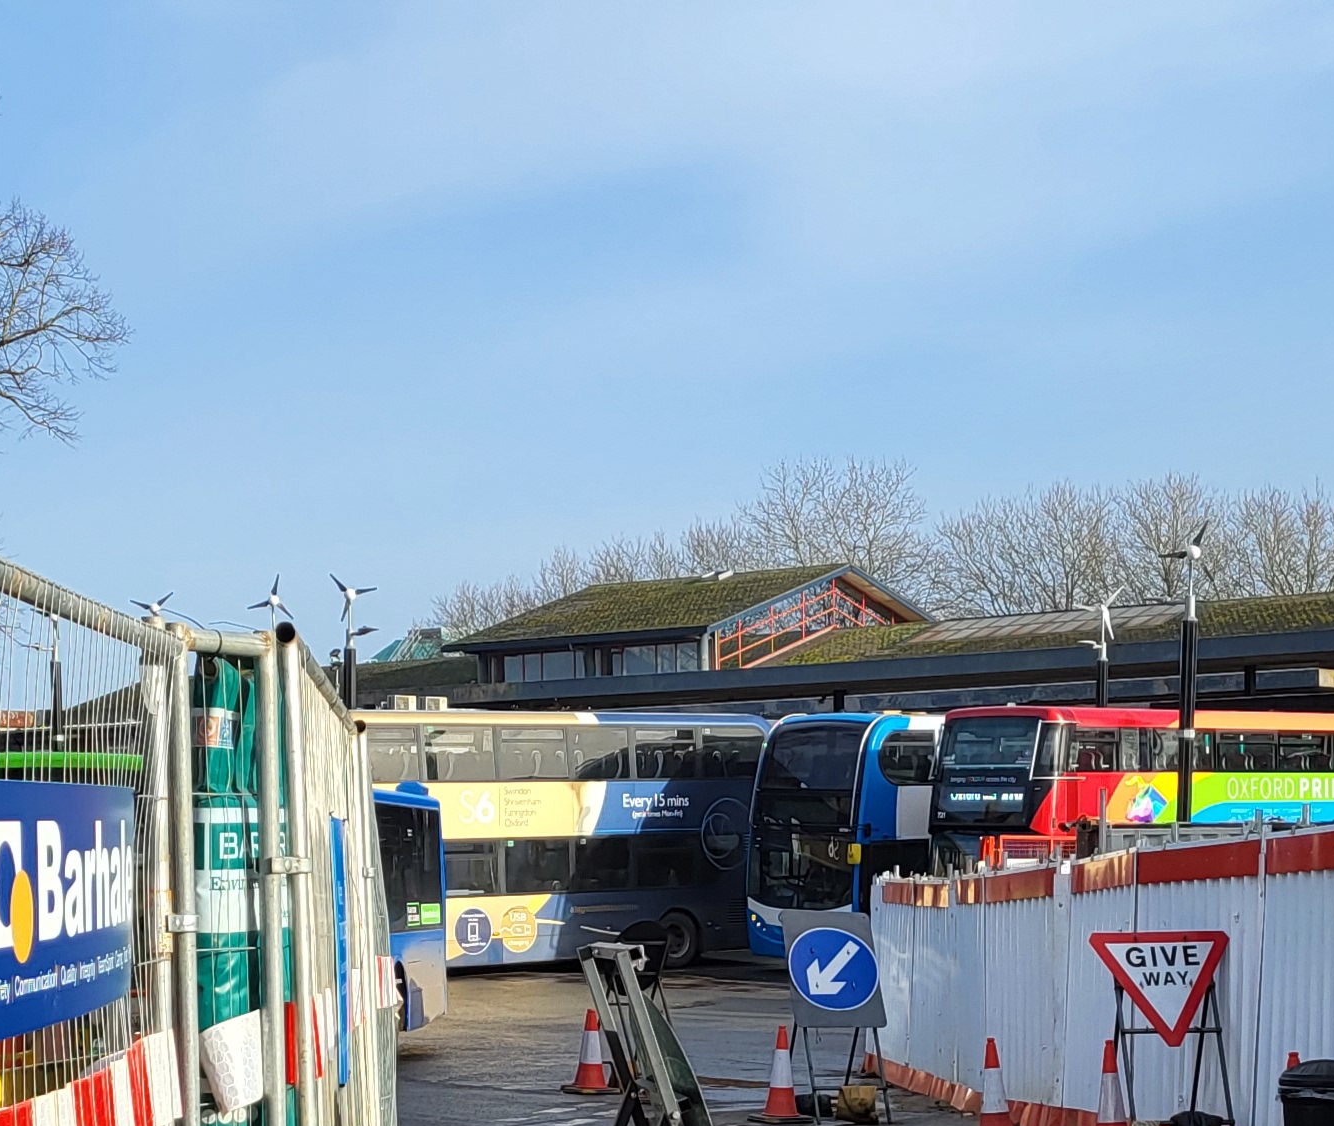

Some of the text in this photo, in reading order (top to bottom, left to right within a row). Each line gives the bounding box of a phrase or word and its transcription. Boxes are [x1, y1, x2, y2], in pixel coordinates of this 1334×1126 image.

[504, 787, 532, 796] Swindon
[1227, 777, 1295, 799] OXFORD
[459, 790, 496, 824] S6
[622, 793, 690, 811] Every 15 mins
[505, 819, 529, 827] Oxford
[36, 820, 133, 943] Barhale
[509, 912, 527, 922] USB
[1124, 942, 1202, 968] GIVE
[14, 968, 58, 998] Communication
[61, 964, 78, 988] Quality
[1143, 970, 1189, 988] WAY
